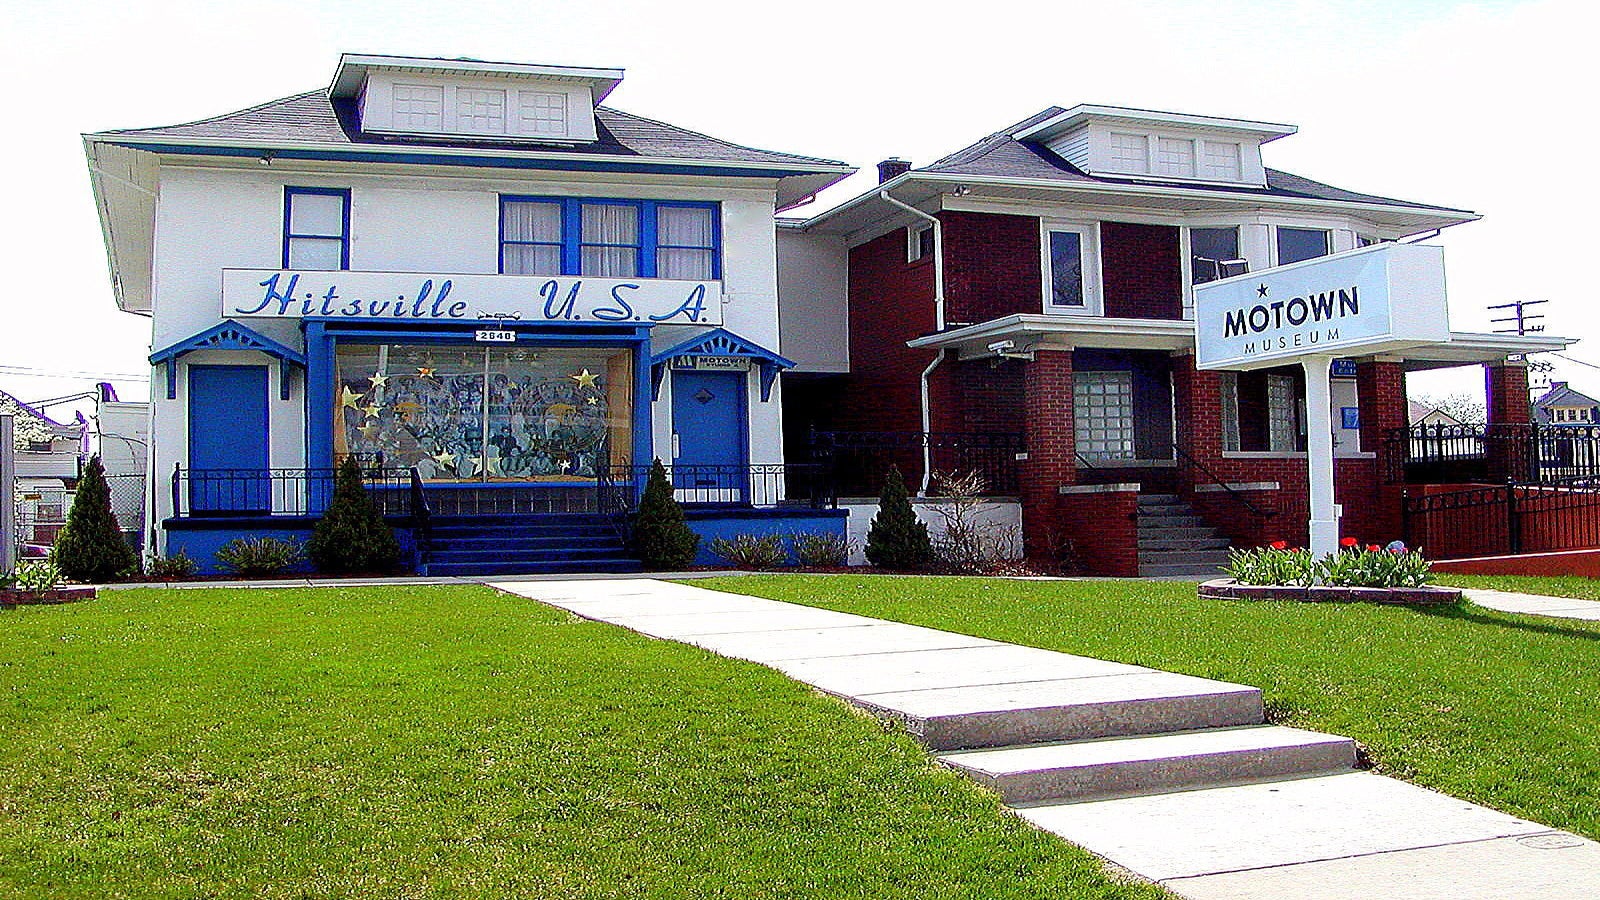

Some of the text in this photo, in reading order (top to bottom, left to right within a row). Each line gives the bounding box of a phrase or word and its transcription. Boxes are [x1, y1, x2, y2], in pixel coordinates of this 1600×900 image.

[235, 272, 467, 317] Hitsville
[1224, 286, 1360, 338] MOTOWN
[1244, 328, 1340, 354] MUSEUM
